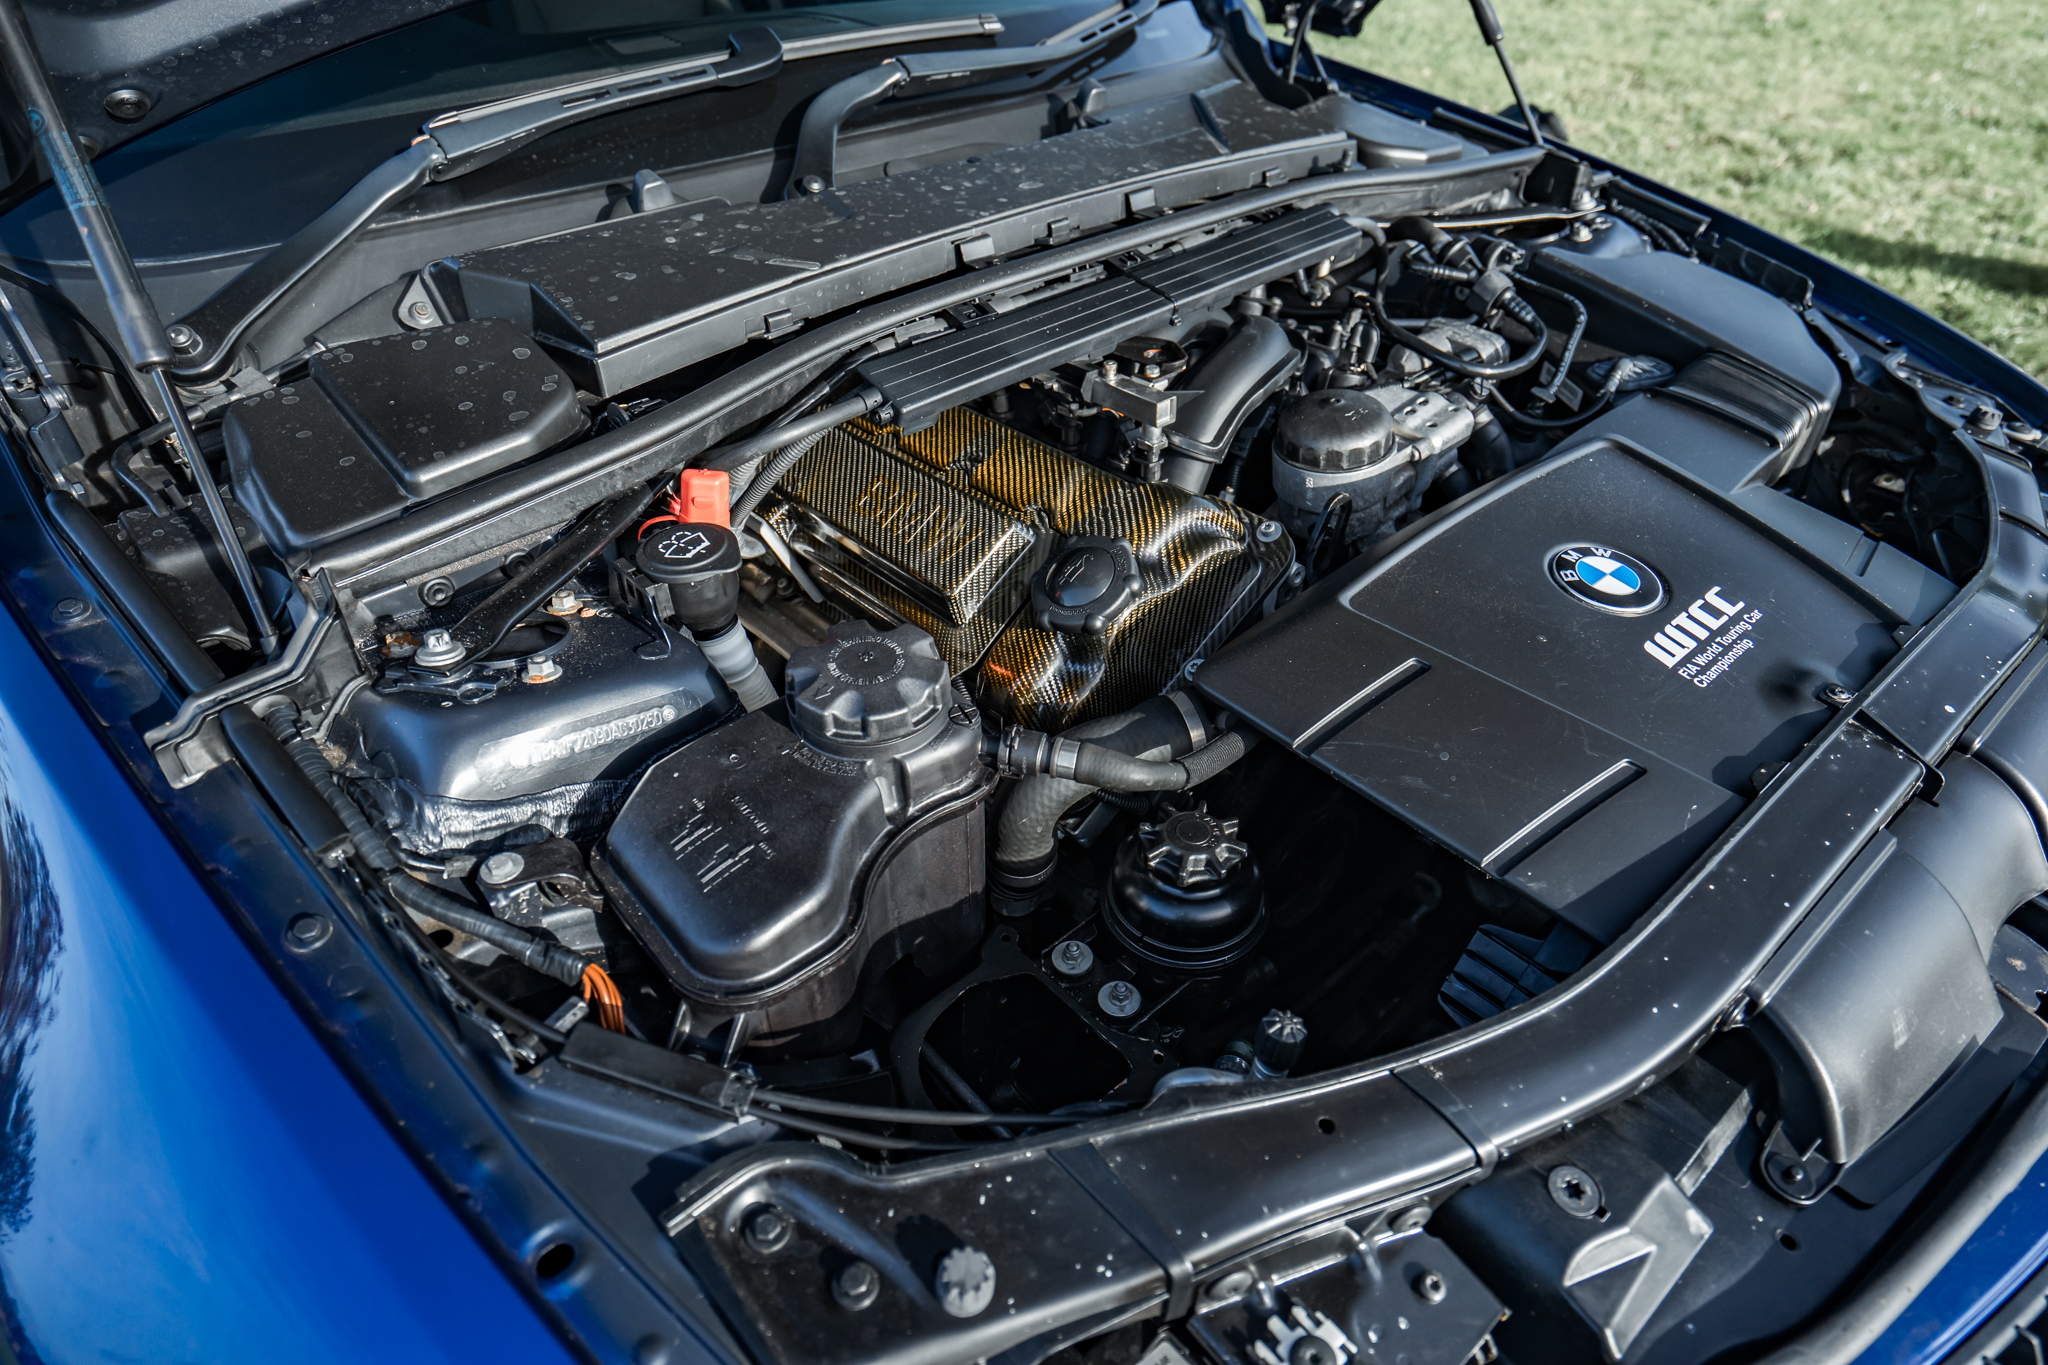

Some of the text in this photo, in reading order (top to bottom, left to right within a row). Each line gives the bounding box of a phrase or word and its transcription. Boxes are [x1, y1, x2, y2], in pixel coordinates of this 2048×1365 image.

[1560, 547, 1613, 581] BMW
[1643, 585, 1746, 669] WTCC
[1677, 609, 1763, 680] FIA World Touring Car
[1693, 638, 1755, 688] Championship
